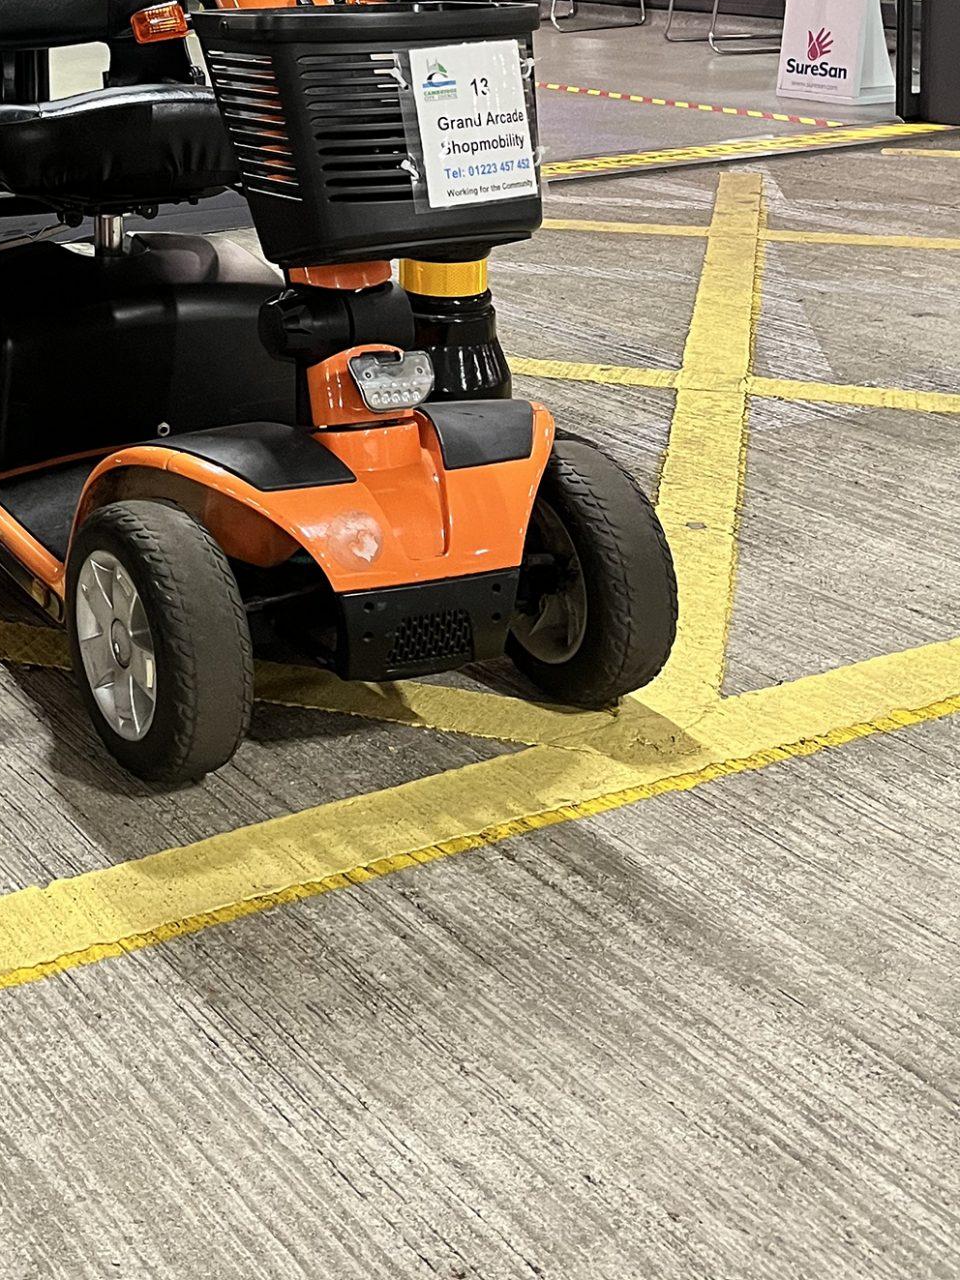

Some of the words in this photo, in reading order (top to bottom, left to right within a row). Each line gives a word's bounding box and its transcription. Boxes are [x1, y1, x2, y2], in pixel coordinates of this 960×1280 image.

[786, 58, 847, 79] SureSan
[470, 77, 489, 96] 13
[437, 113, 482, 131] Grand
[486, 109, 524, 126] Arcade
[445, 168, 466, 179] Tel:
[469, 163, 498, 177] 01223
[500, 160, 515, 172] 457
[517, 158, 530, 170] 452
[447, 187, 478, 197] Working
[480, 184, 490, 194] for
[491, 183, 501, 192] the
[502, 179, 533, 190] Community
